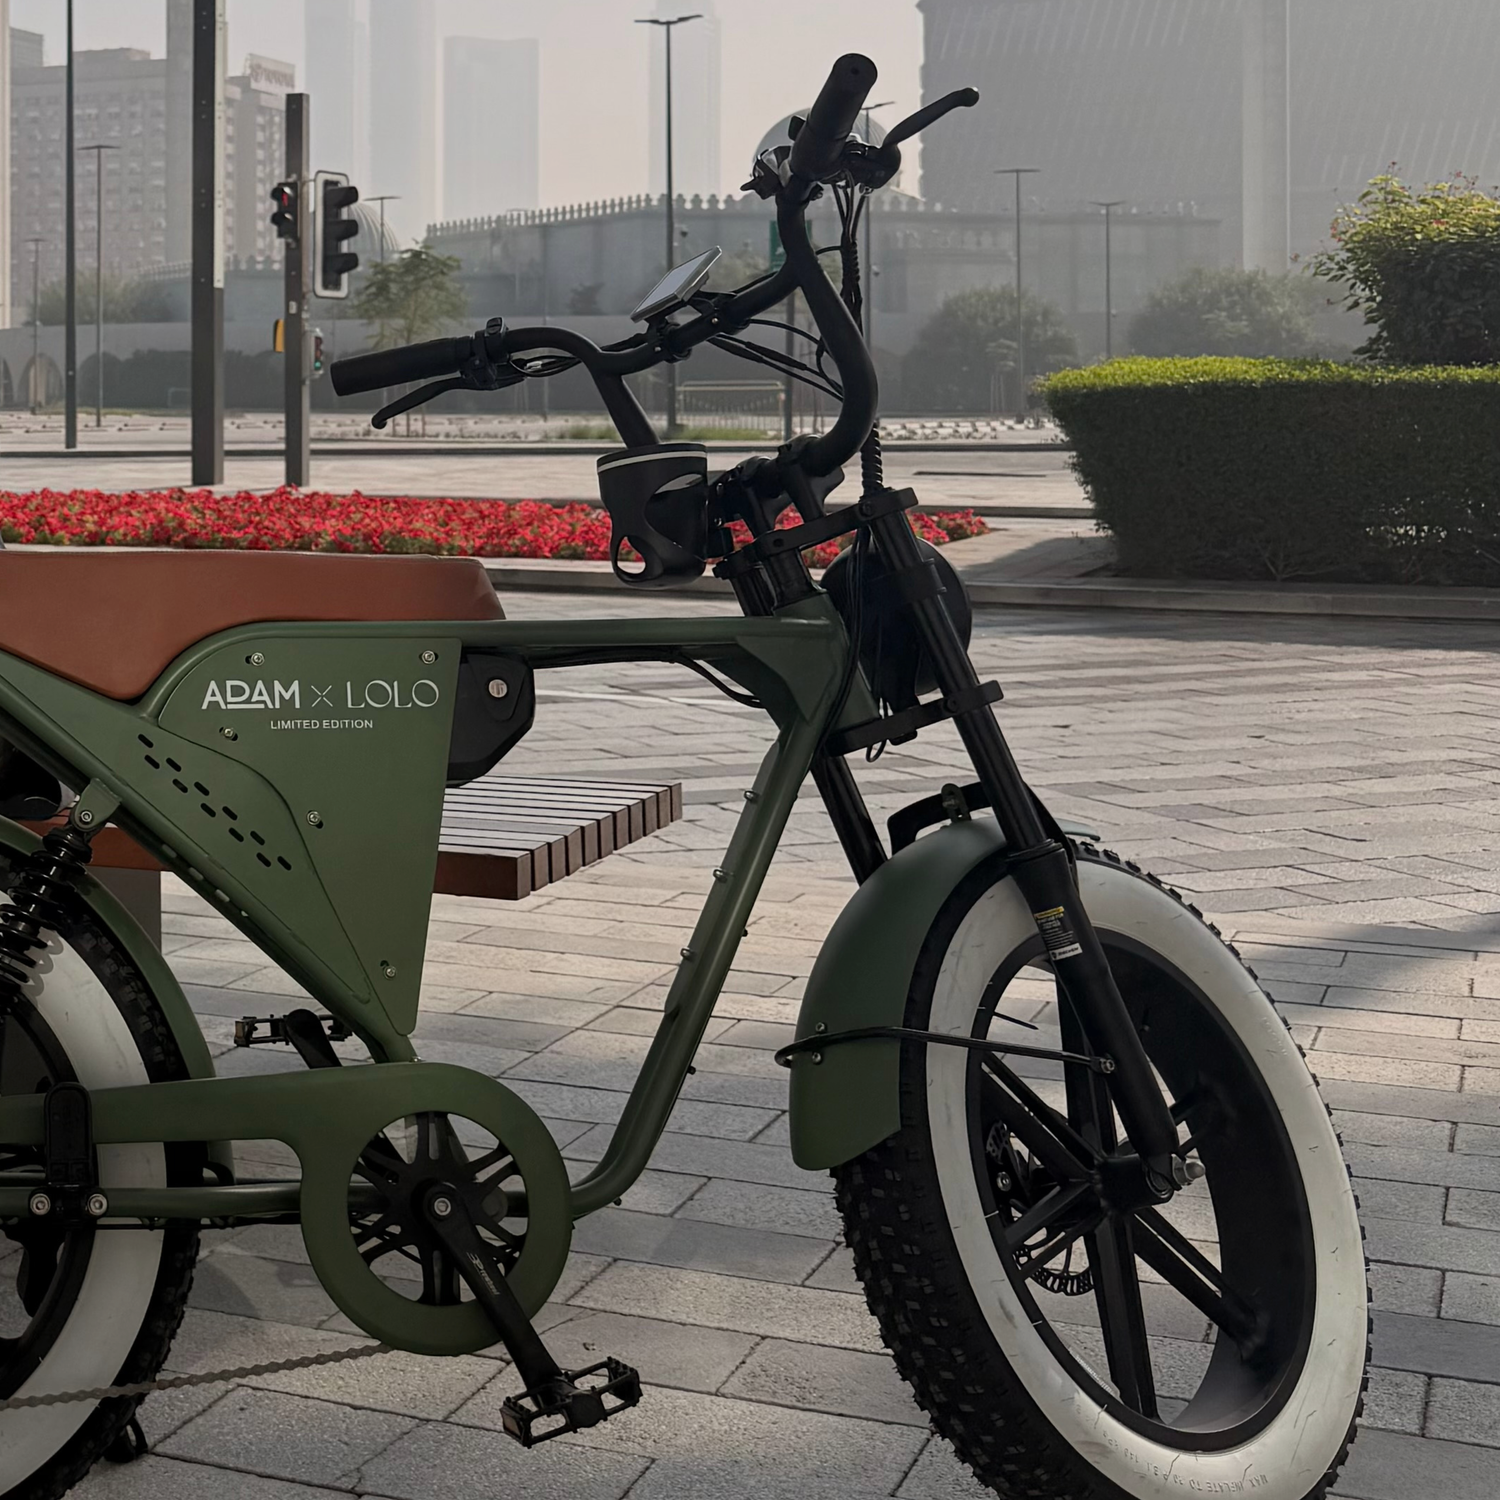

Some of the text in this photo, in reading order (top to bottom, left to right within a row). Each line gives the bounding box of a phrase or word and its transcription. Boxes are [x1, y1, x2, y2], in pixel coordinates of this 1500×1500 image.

[201, 679, 301, 709] ADAM
[346, 679, 439, 709] LOLO
[270, 719, 373, 730] LIMITED EDITION
